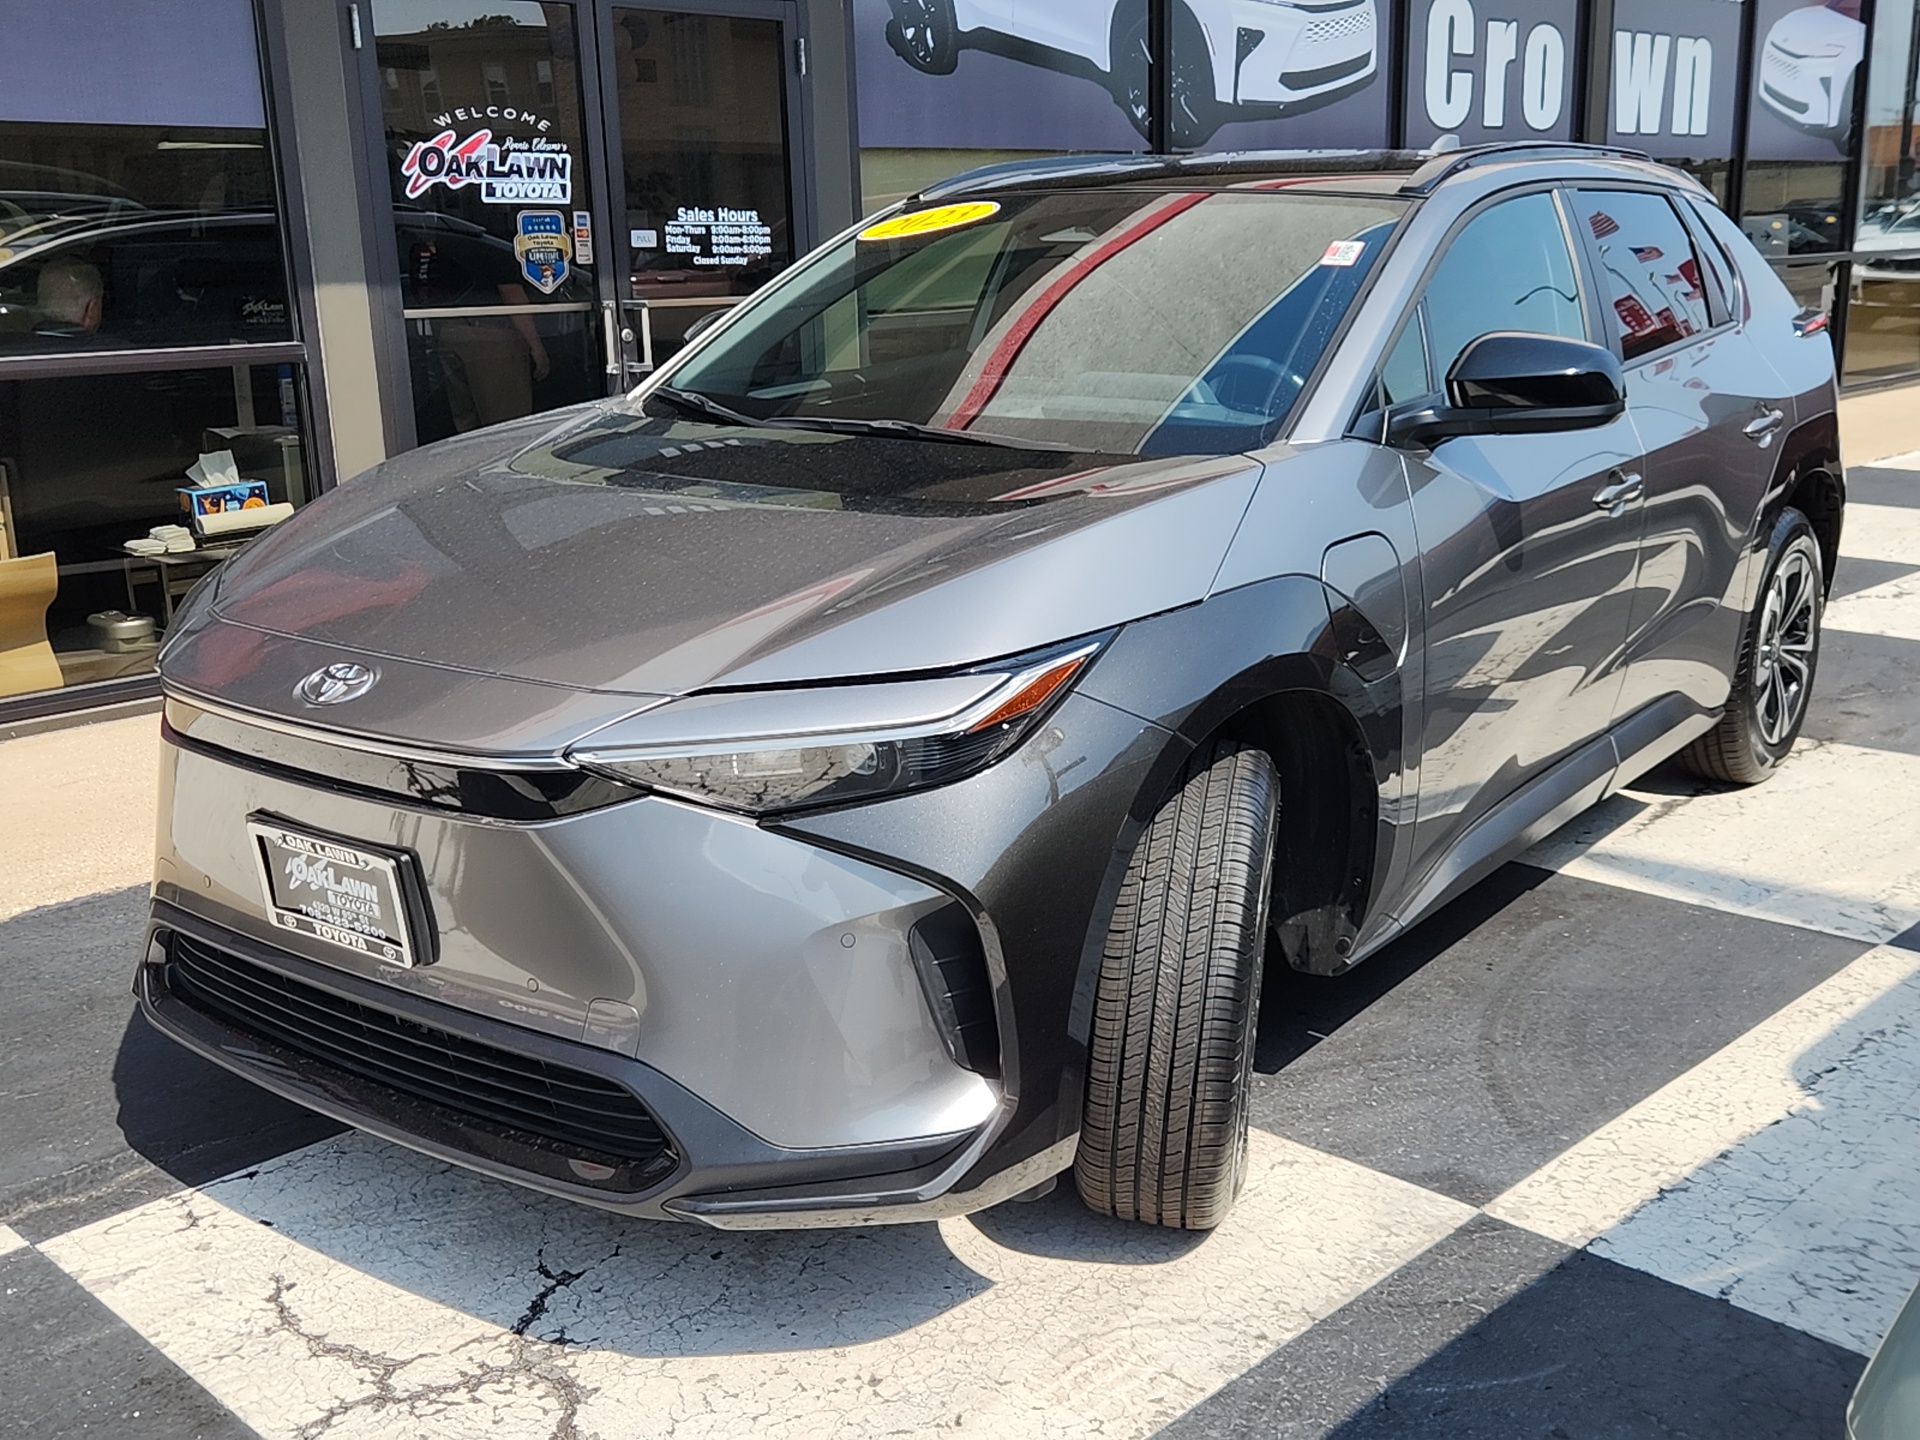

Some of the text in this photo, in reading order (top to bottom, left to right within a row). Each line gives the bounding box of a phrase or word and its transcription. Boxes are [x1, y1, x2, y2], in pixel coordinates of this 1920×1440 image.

[433, 106, 552, 132] WELCOME
[492, 182, 563, 199] TOYOTA
[677, 206, 759, 222] Sales Hours
[665, 225, 706, 234] Mon-Thurs
[665, 235, 691, 245] Friday
[666, 244, 701, 254] Saturday
[693, 255, 748, 266] Closed Sunday
[285, 835, 357, 865] OAK LAWN
[332, 893, 375, 915] TOYOTA
[299, 904, 387, 940] 708-423-5200
[312, 922, 368, 951] TOYOTA
